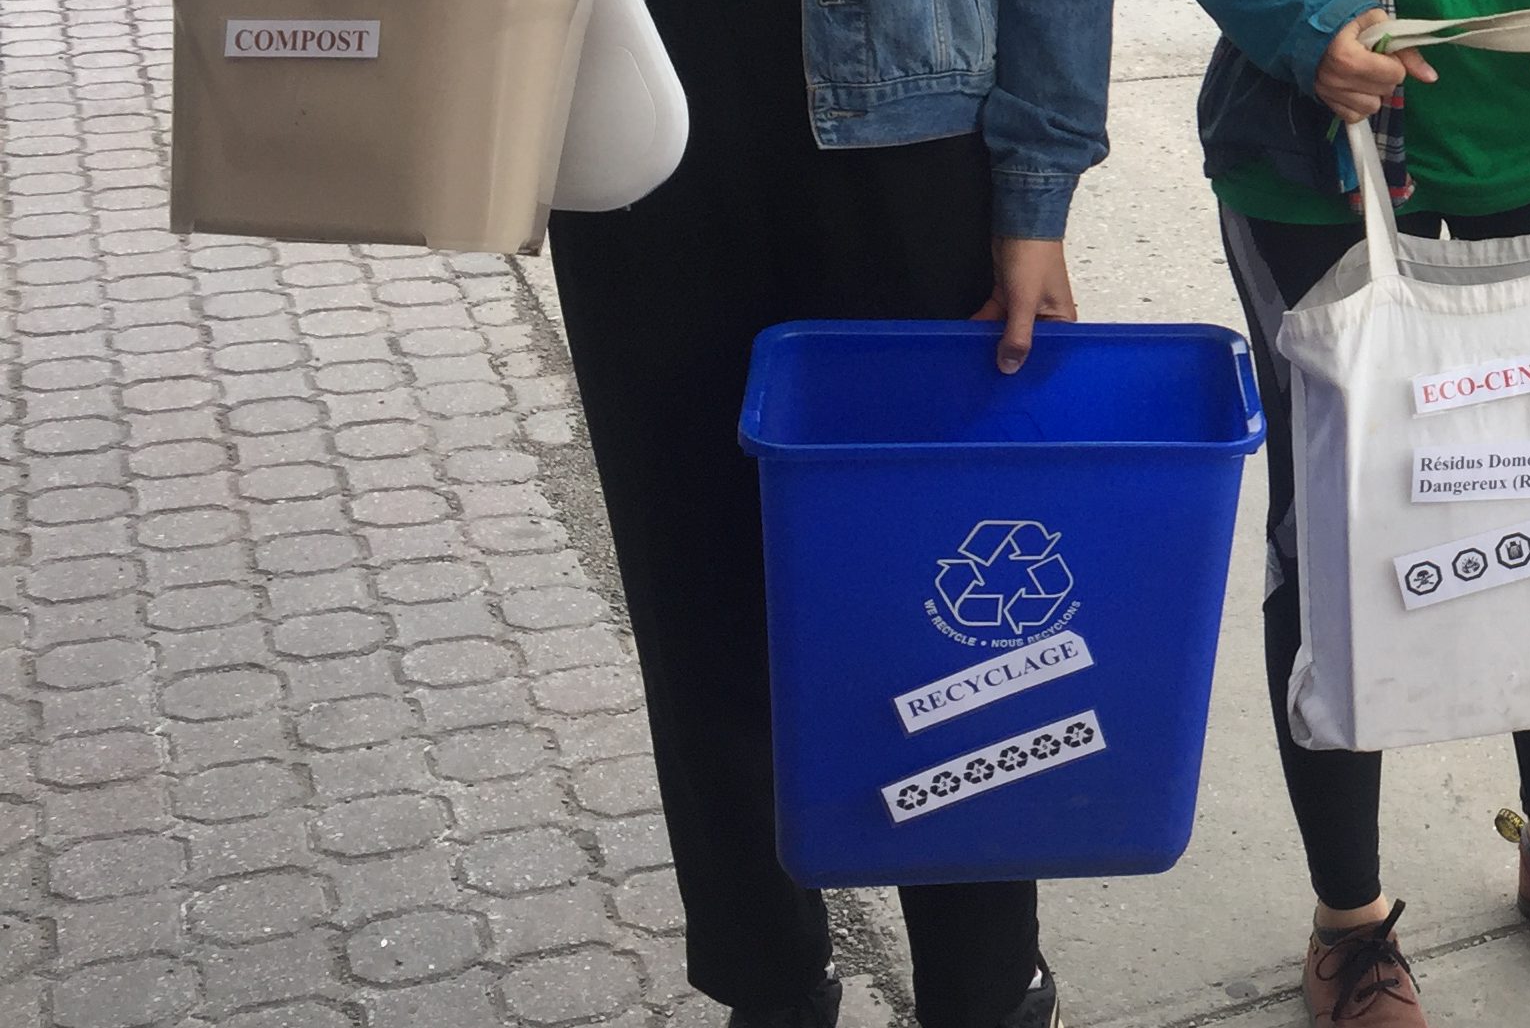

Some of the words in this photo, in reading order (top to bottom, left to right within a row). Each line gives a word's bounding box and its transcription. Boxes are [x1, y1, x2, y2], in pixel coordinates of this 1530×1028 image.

[234, 29, 370, 52] COMPOST
[1420, 456, 1484, 472] Résidus
[1419, 477, 1507, 496] Dangereux
[924, 598, 938, 616] WE
[931, 615, 977, 647] RECYCLE
[991, 638, 1024, 648] NOUS
[1027, 600, 1081, 643] RECYCLONS
[907, 640, 1079, 719] RECYCLAGE
